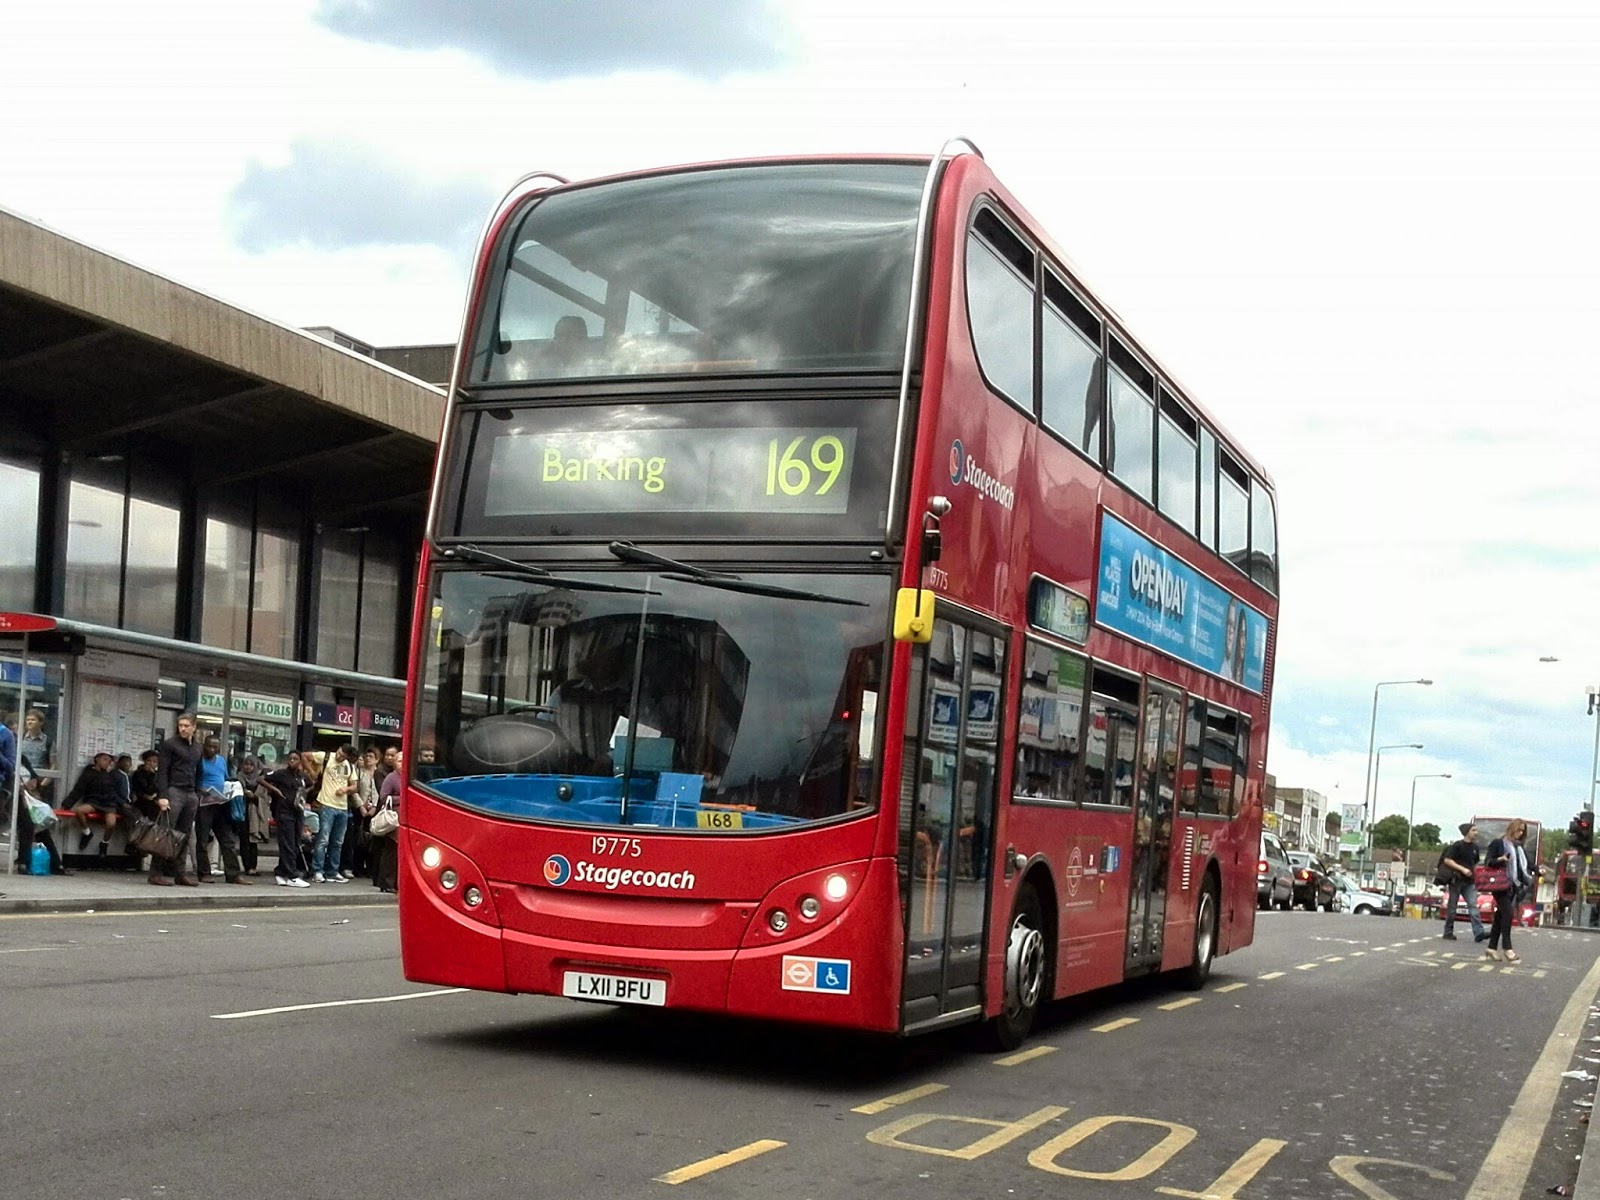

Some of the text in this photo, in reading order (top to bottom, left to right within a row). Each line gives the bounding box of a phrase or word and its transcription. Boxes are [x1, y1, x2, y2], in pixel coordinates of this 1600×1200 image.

[542, 435, 844, 496] Barking 169
[963, 454, 1015, 511] Stagecoach
[200, 693, 249, 710] STAION
[338, 711, 353, 724] c2c
[374, 714, 400, 729] Barking
[707, 813, 732, 828] 168
[592, 836, 641, 858] 19775
[574, 861, 695, 890] Stagecoach
[578, 975, 651, 1000] LX11 BFU
